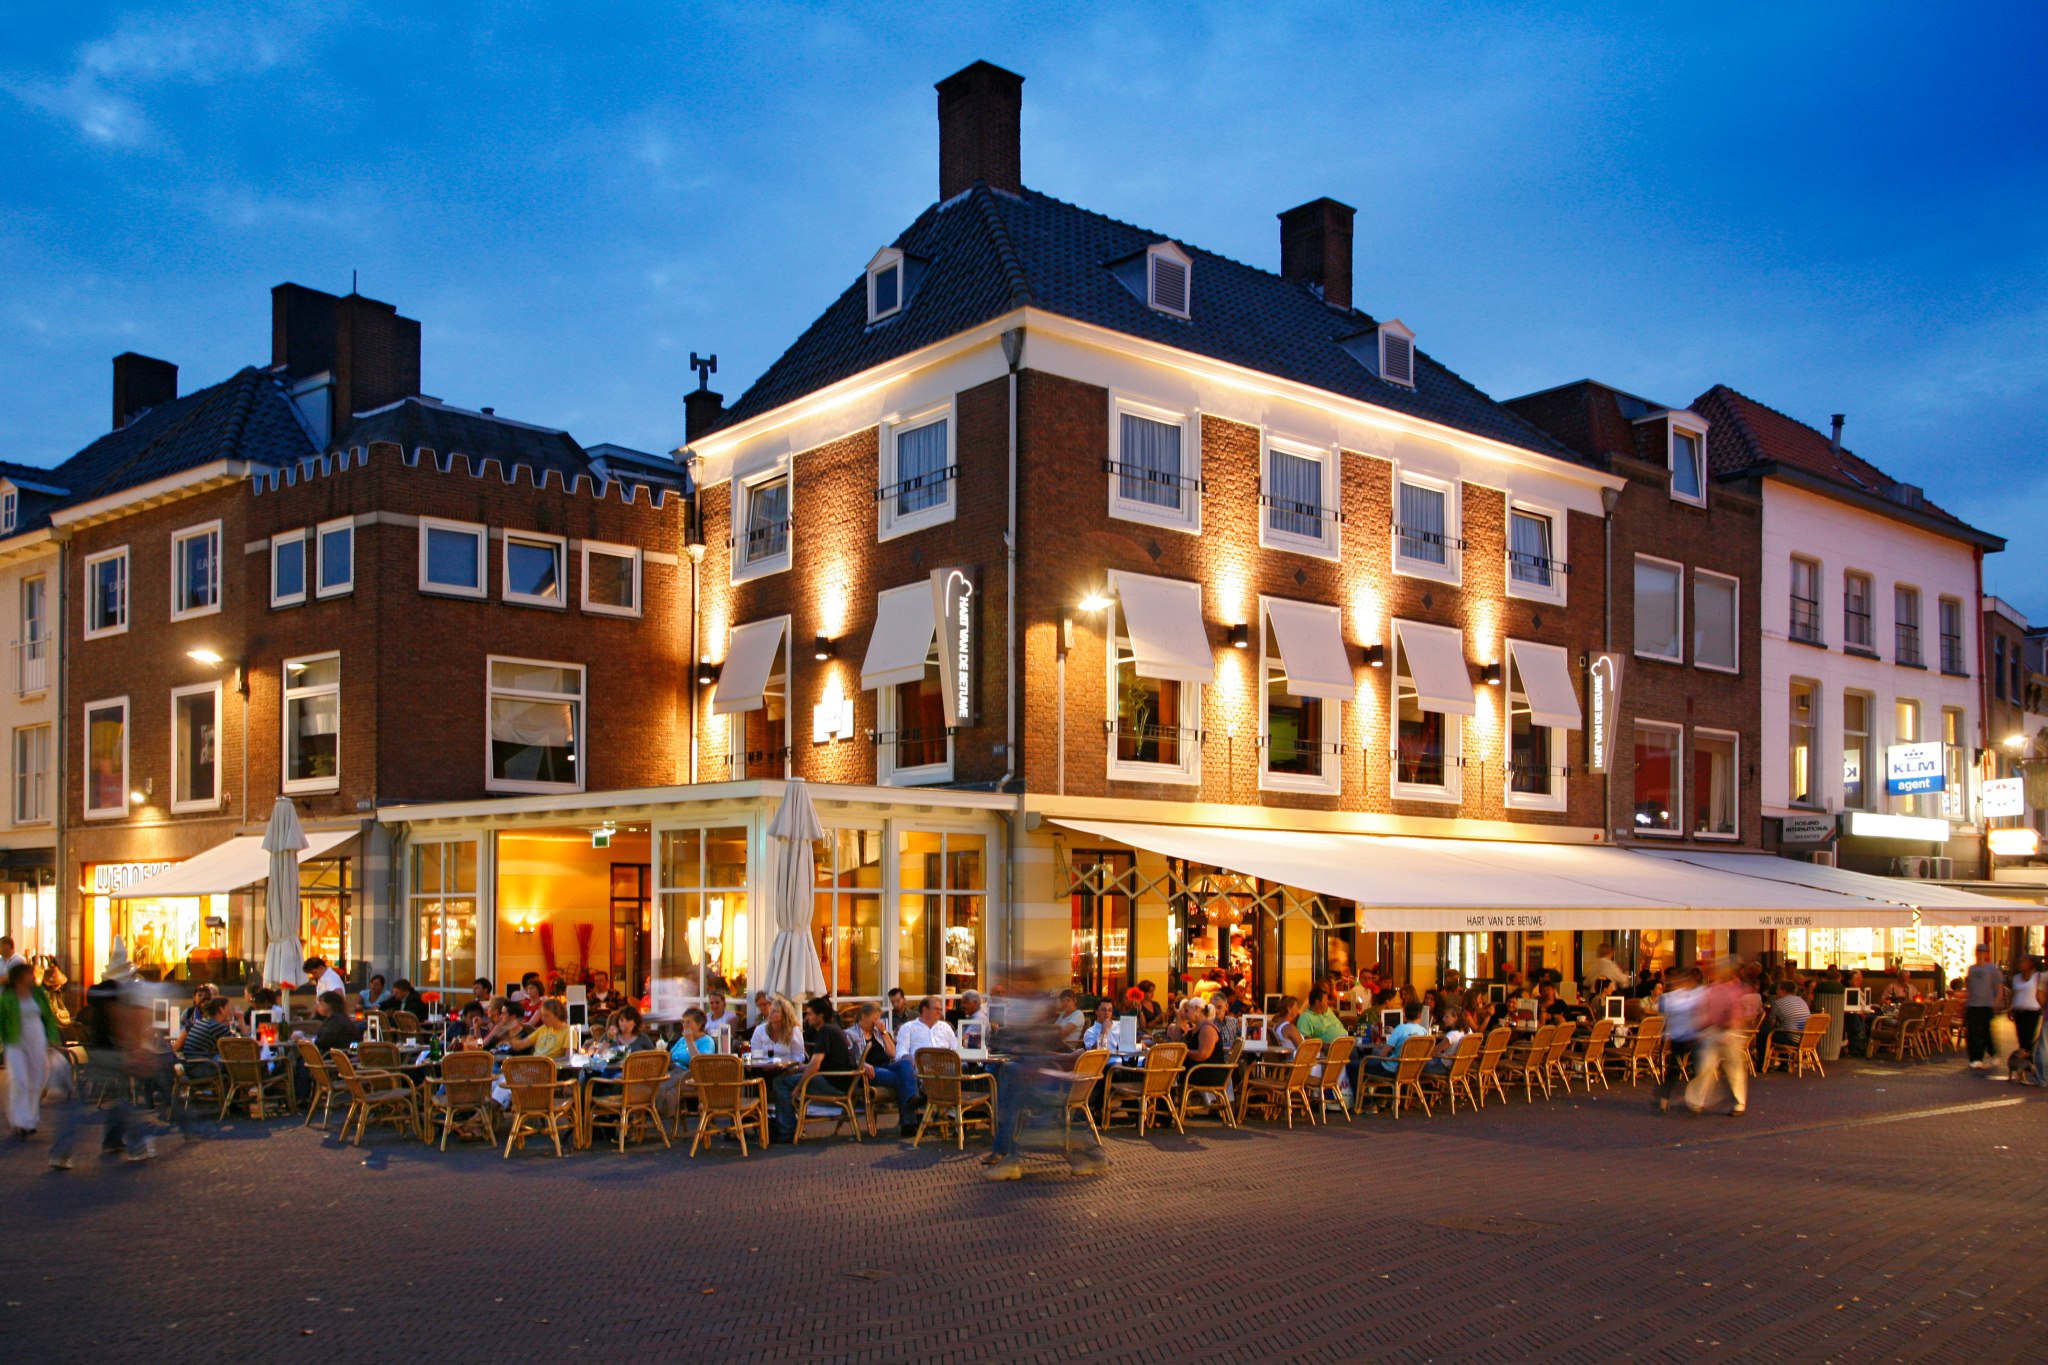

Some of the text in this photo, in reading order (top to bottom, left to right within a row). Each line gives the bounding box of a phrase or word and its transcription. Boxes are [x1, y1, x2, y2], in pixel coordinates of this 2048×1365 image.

[959, 596, 969, 718] HART VAN DE BETUWE
[1595, 712, 1603, 724] DE
[1595, 725, 1603, 744] VAN
[1595, 743, 1603, 768] HART
[1893, 761, 1935, 773] KLM
[1898, 778, 1930, 791] agent
[1785, 825, 1828, 833] INTERNATIONAL
[1466, 916, 1543, 926] HART VAN DE BETUWE
[1758, 916, 1812, 925] HART VAN DE BETUWE
